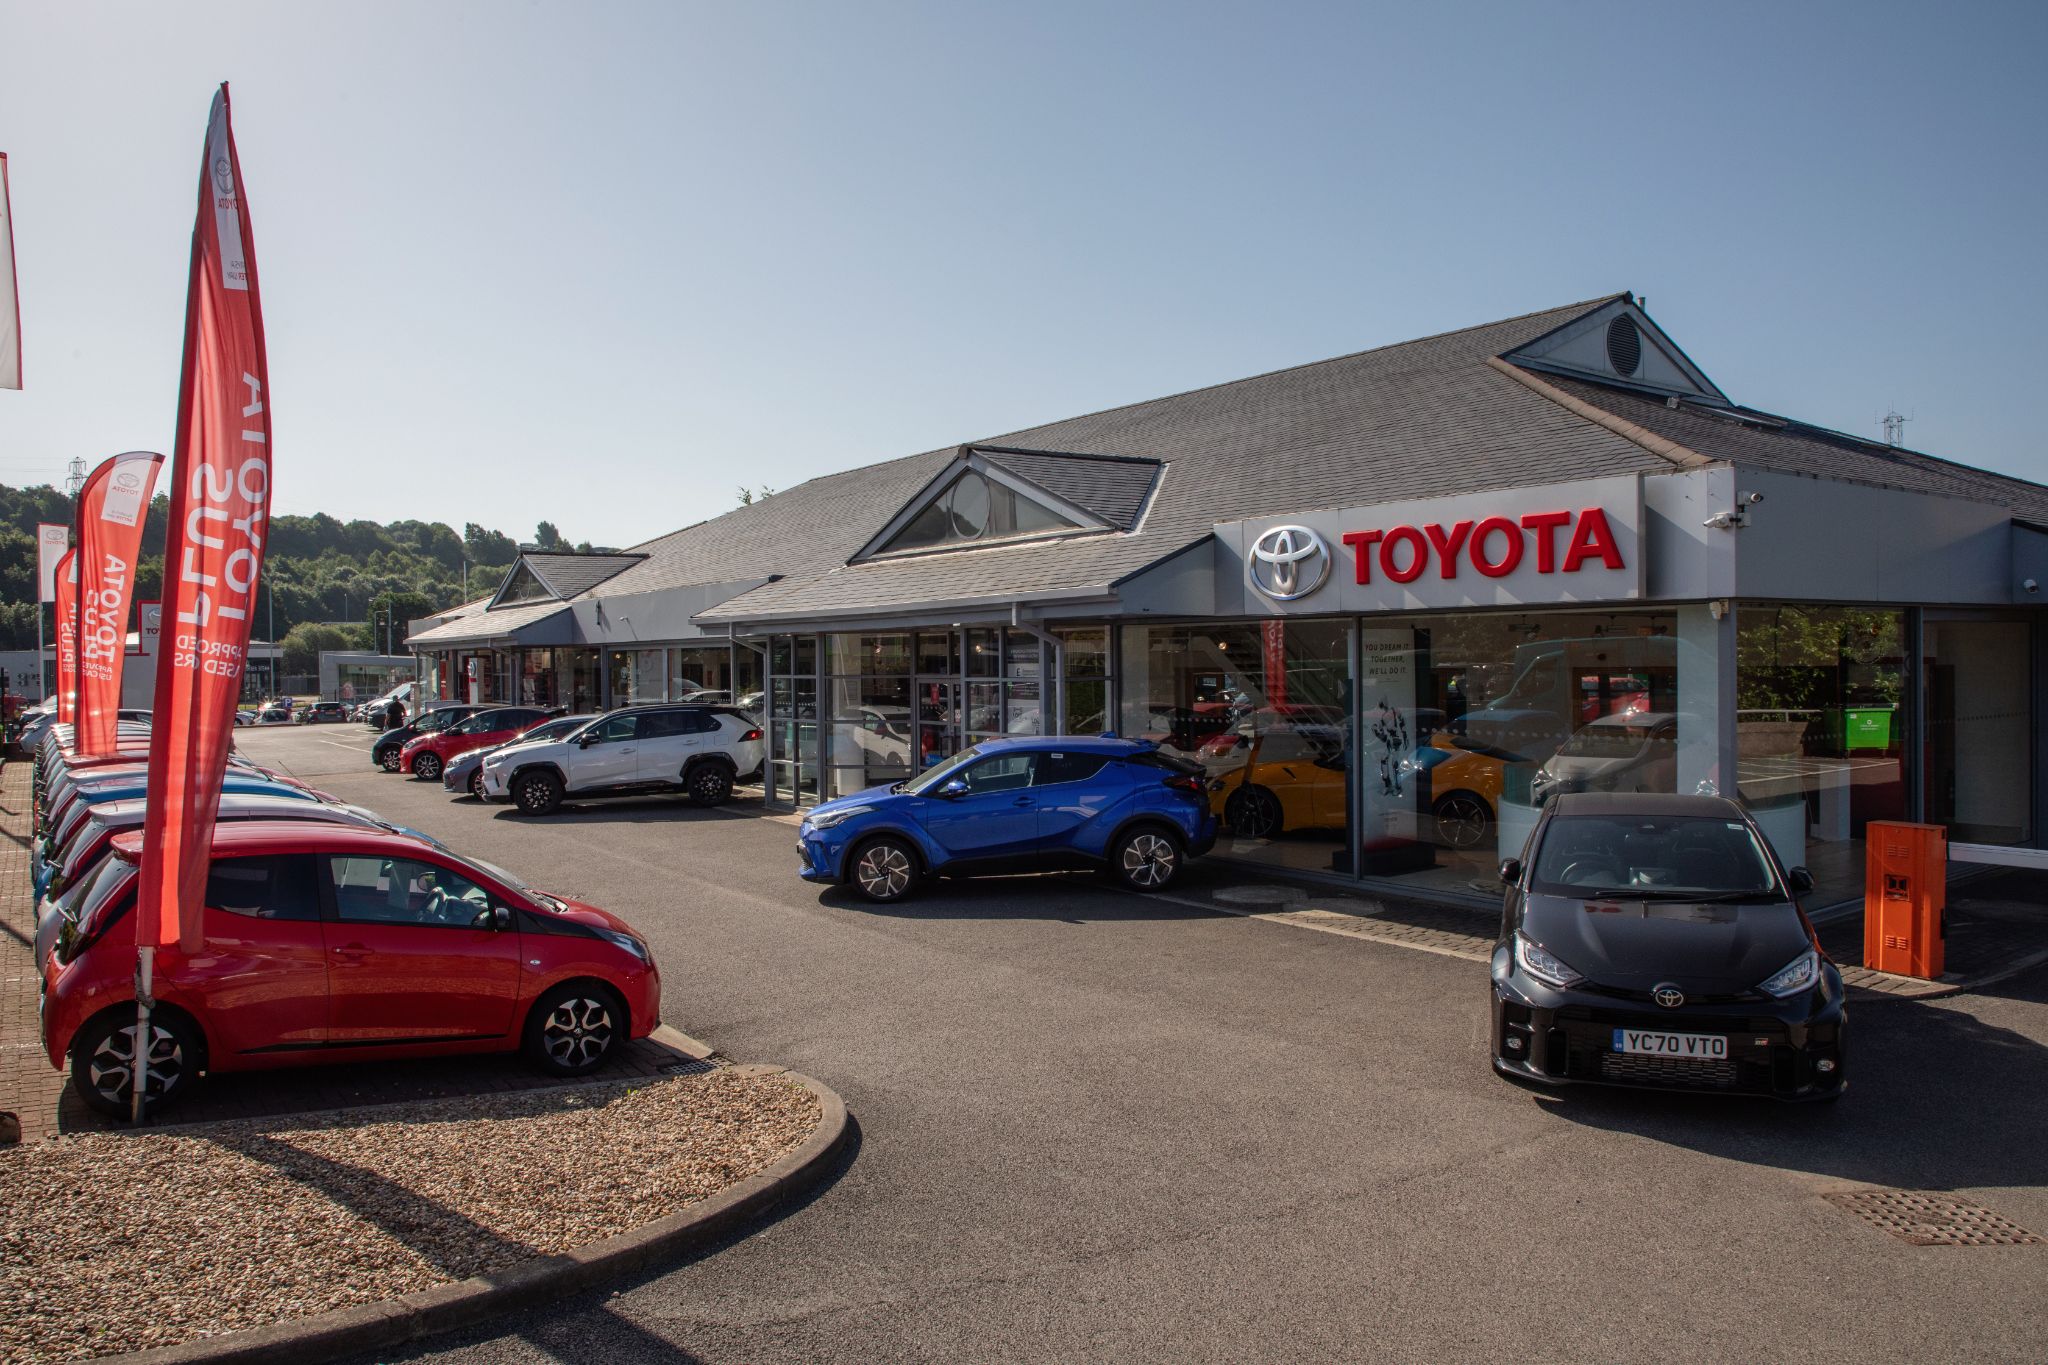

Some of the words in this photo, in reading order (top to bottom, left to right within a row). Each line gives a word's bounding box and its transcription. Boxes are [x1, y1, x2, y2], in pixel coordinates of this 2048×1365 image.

[1342, 507, 1626, 585] TOYOTA
[145, 627, 160, 635] TO
[1365, 643, 1378, 651] YOU
[1380, 643, 1402, 651] DREAM
[285, 698, 292, 708] P
[1628, 1033, 1679, 1053] YC70
[1686, 1036, 1724, 1055] VTO
